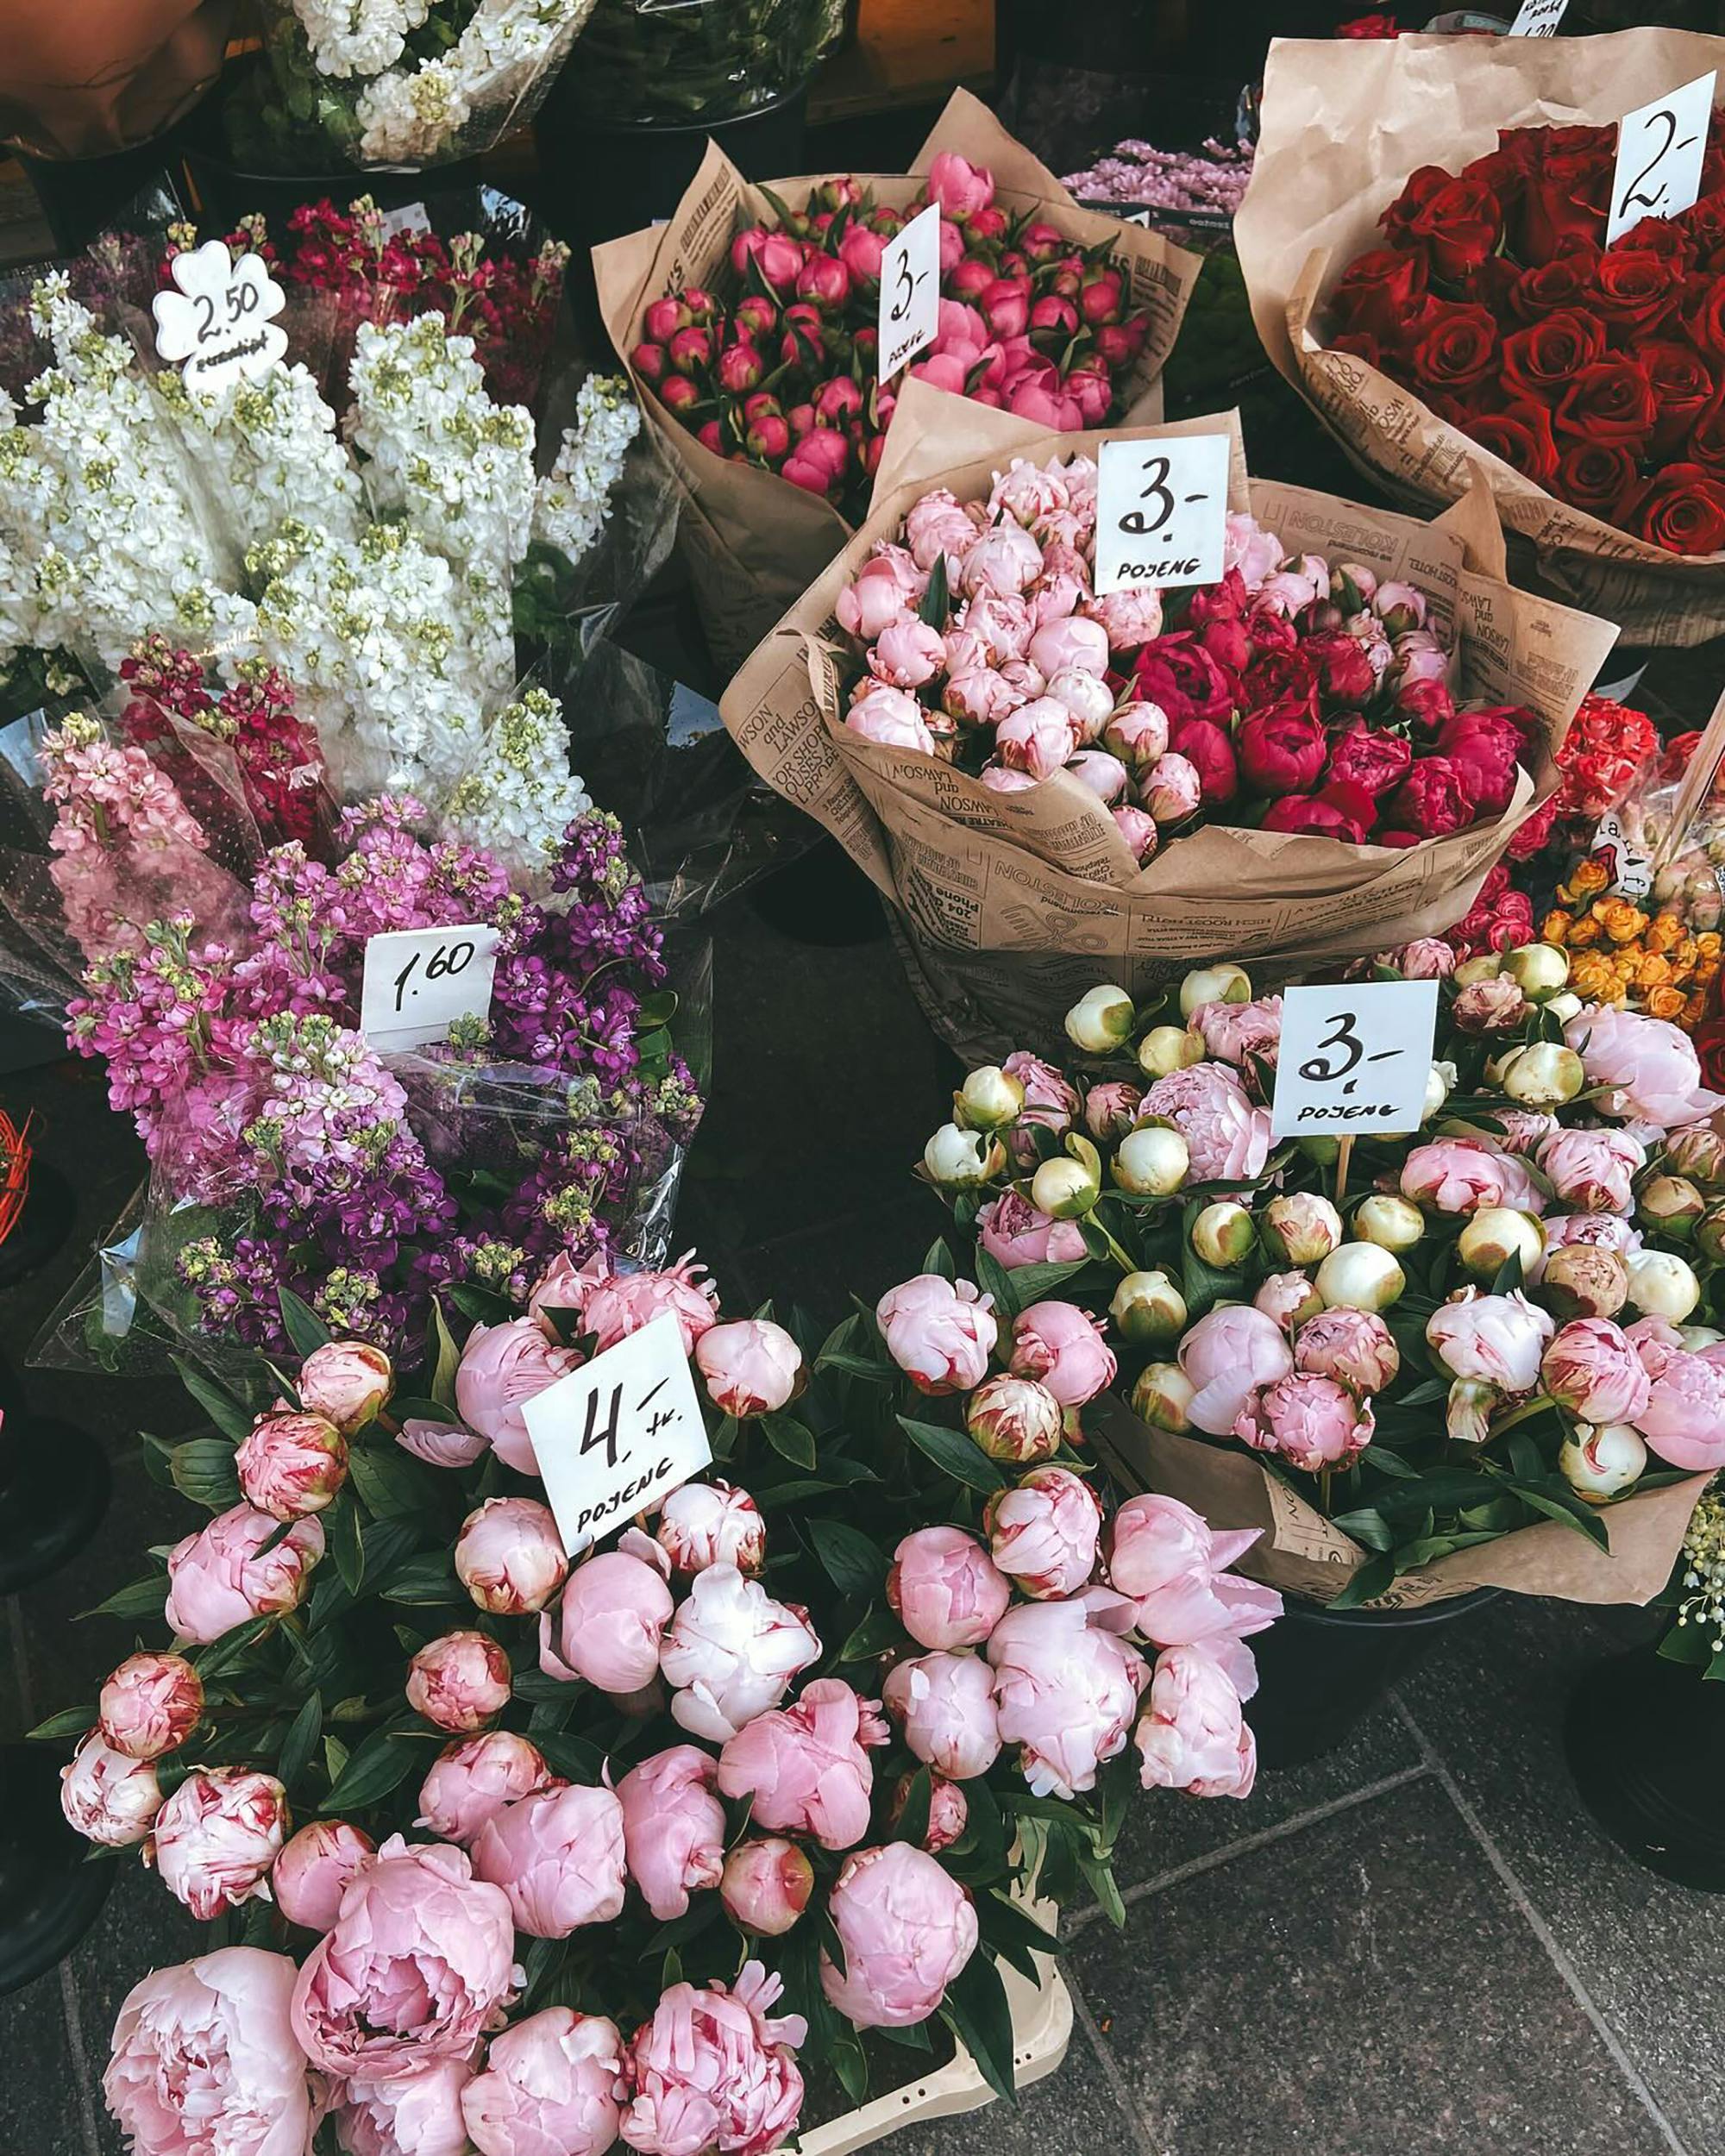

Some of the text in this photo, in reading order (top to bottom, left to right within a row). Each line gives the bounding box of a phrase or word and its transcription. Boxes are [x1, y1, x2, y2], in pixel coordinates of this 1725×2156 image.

[192, 281, 260, 345] 2.50
[1288, 509, 1400, 554] KOLESTON
[762, 713, 787, 745] and
[934, 781, 959, 795] and
[994, 860, 1119, 912] KOLESTON
[1040, 896, 1101, 915] recommend
[393, 941, 475, 1012] 1.60
[577, 1457, 674, 1534] POJENG
